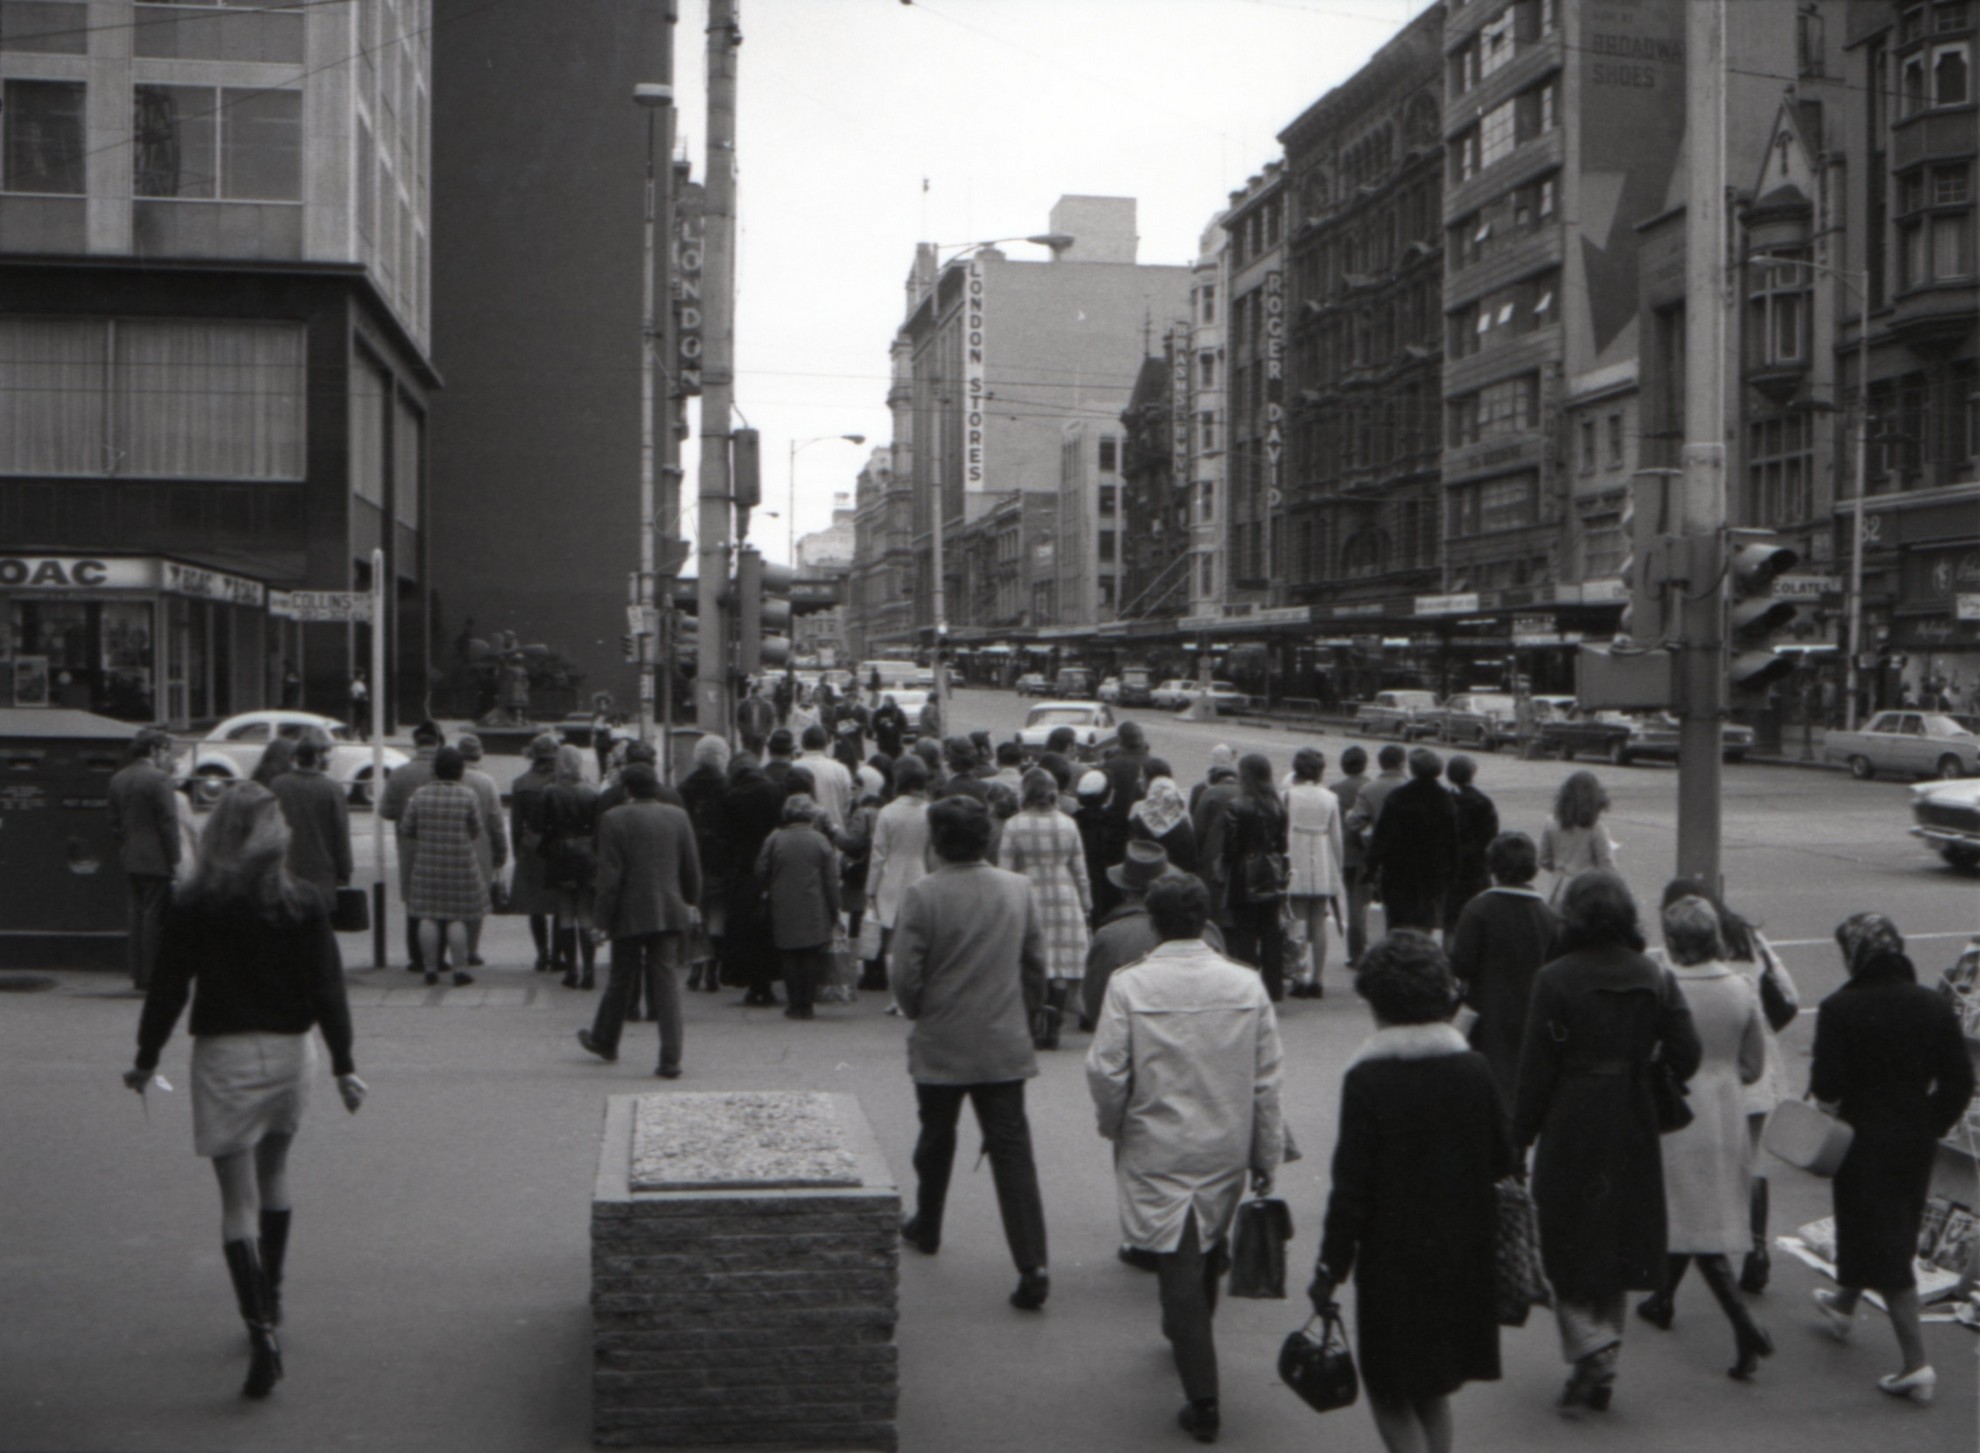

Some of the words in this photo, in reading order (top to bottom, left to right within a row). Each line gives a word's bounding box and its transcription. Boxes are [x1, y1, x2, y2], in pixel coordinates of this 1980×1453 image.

[1592, 34, 1686, 63] BROADWA
[1592, 62, 1655, 88] SHOES
[681, 221, 702, 387] LONDON
[969, 263, 982, 364] LONDON
[1267, 273, 1282, 379] ROGER
[969, 377, 982, 482] STORES
[1267, 403, 1283, 506] DAVID
[0, 560, 107, 586] OAC
[291, 592, 351, 609] COLLINS
